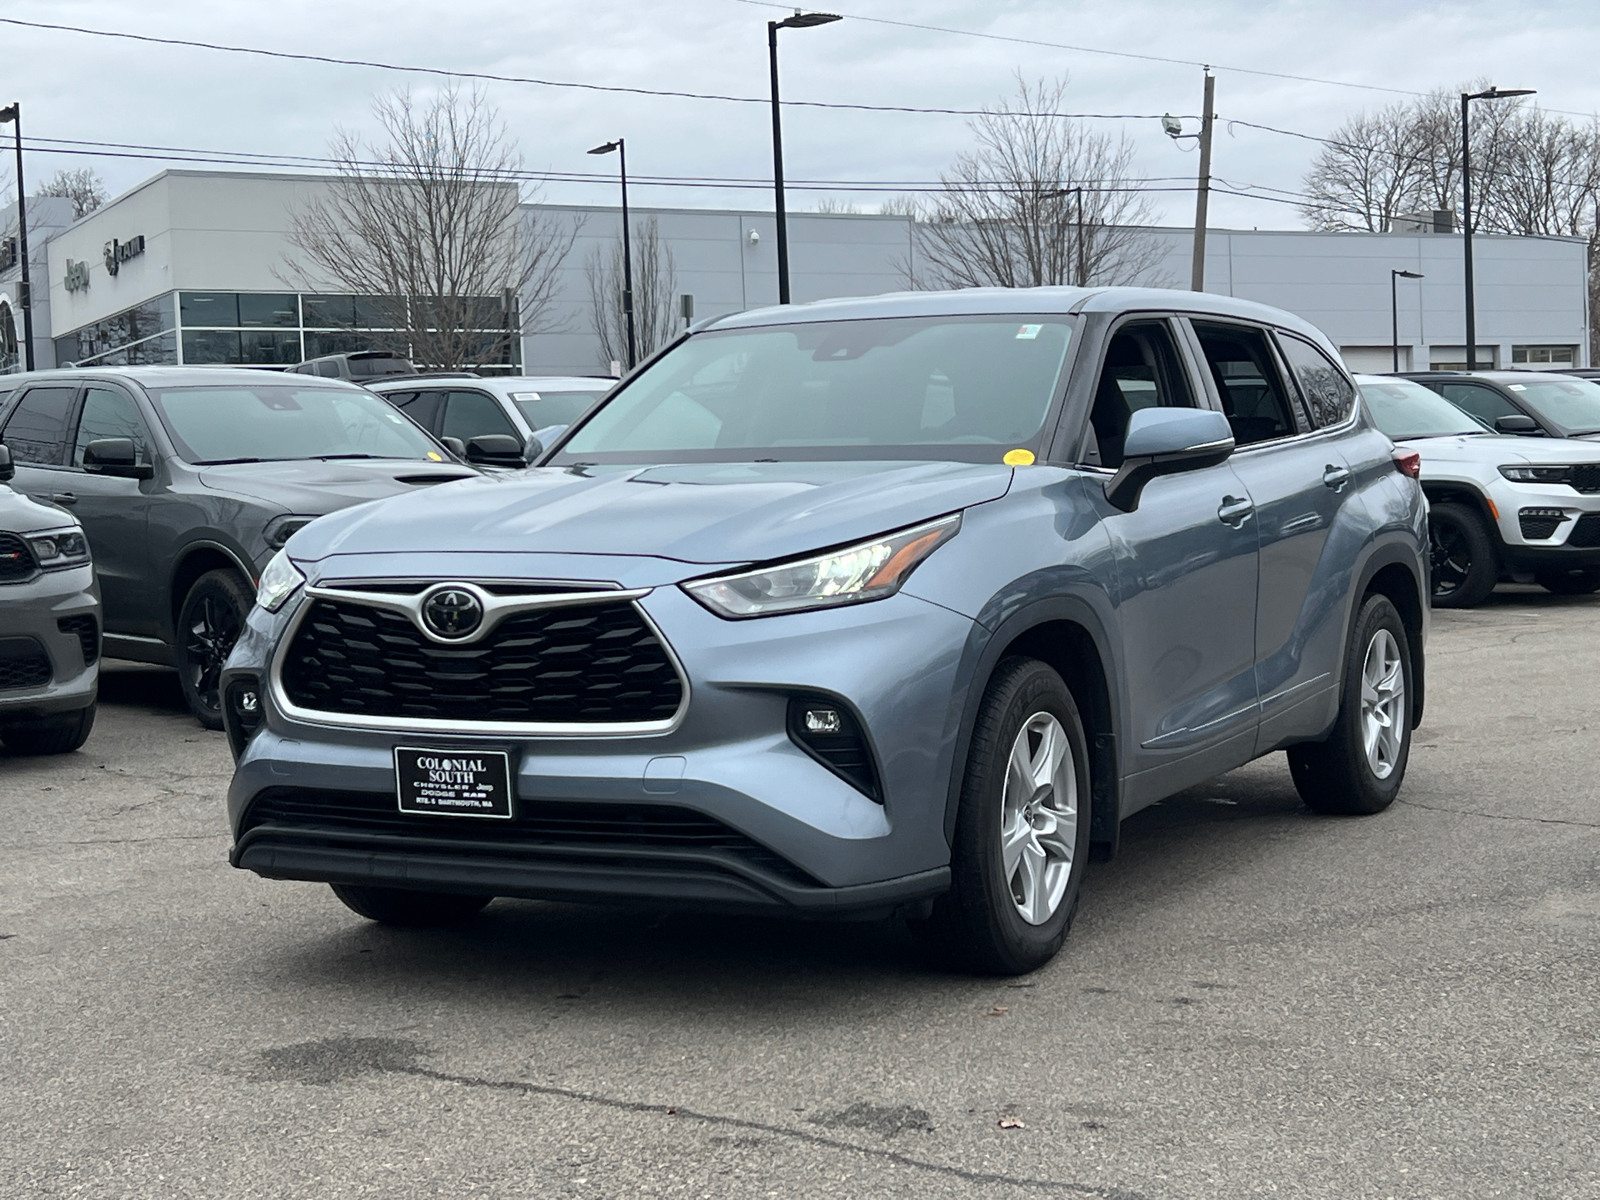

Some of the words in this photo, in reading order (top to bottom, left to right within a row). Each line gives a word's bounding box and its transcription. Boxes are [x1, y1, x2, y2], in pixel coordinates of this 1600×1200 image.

[115, 235, 145, 263] RAM
[417, 757, 487, 772] COLONIAL
[429, 770, 474, 783] SOUTH
[413, 781, 470, 790] CHRYSLER
[421, 789, 456, 798] DODGE
